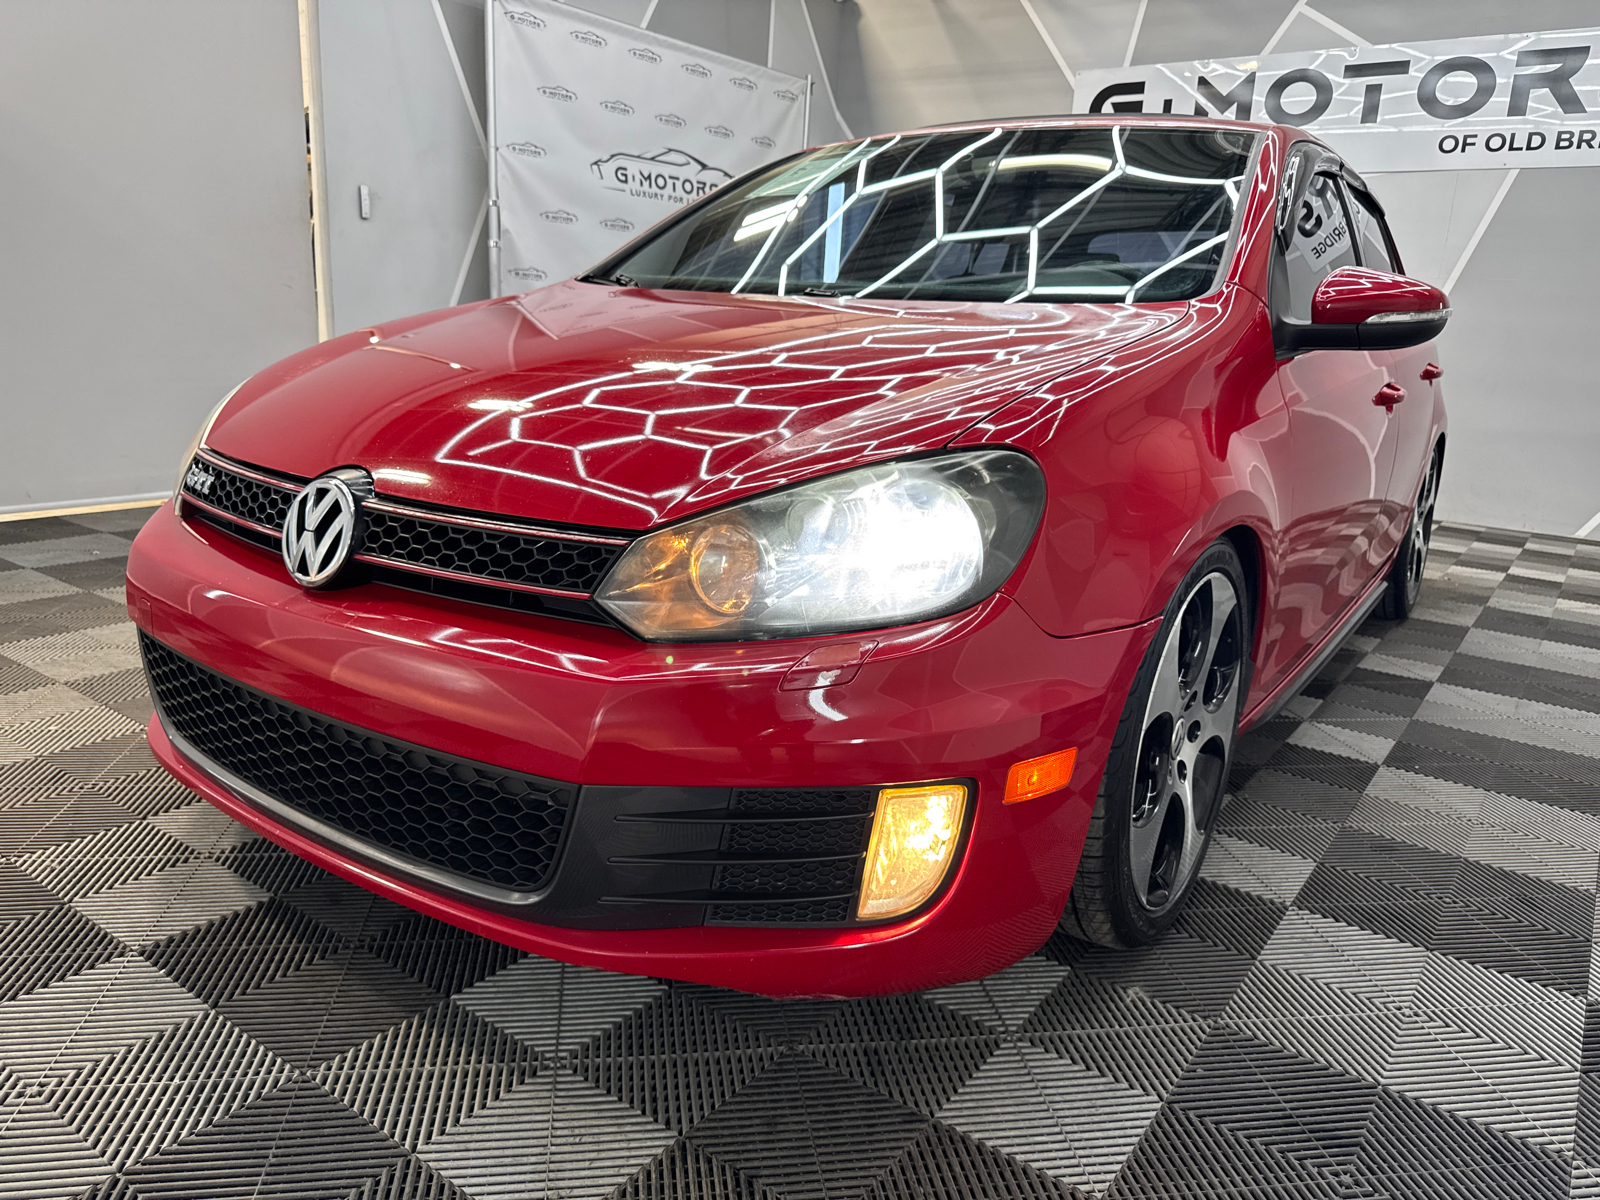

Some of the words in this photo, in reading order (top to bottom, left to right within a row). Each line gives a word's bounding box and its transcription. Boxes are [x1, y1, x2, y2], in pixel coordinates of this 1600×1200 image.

[1194, 46, 1600, 125] MOTOR
[1438, 134, 1478, 154] OF
[1485, 132, 1546, 153] OLD
[1554, 130, 1600, 150] BR
[630, 189, 664, 201] LUXURY
[667, 195, 684, 205] FOR
[186, 468, 215, 495] GTI
